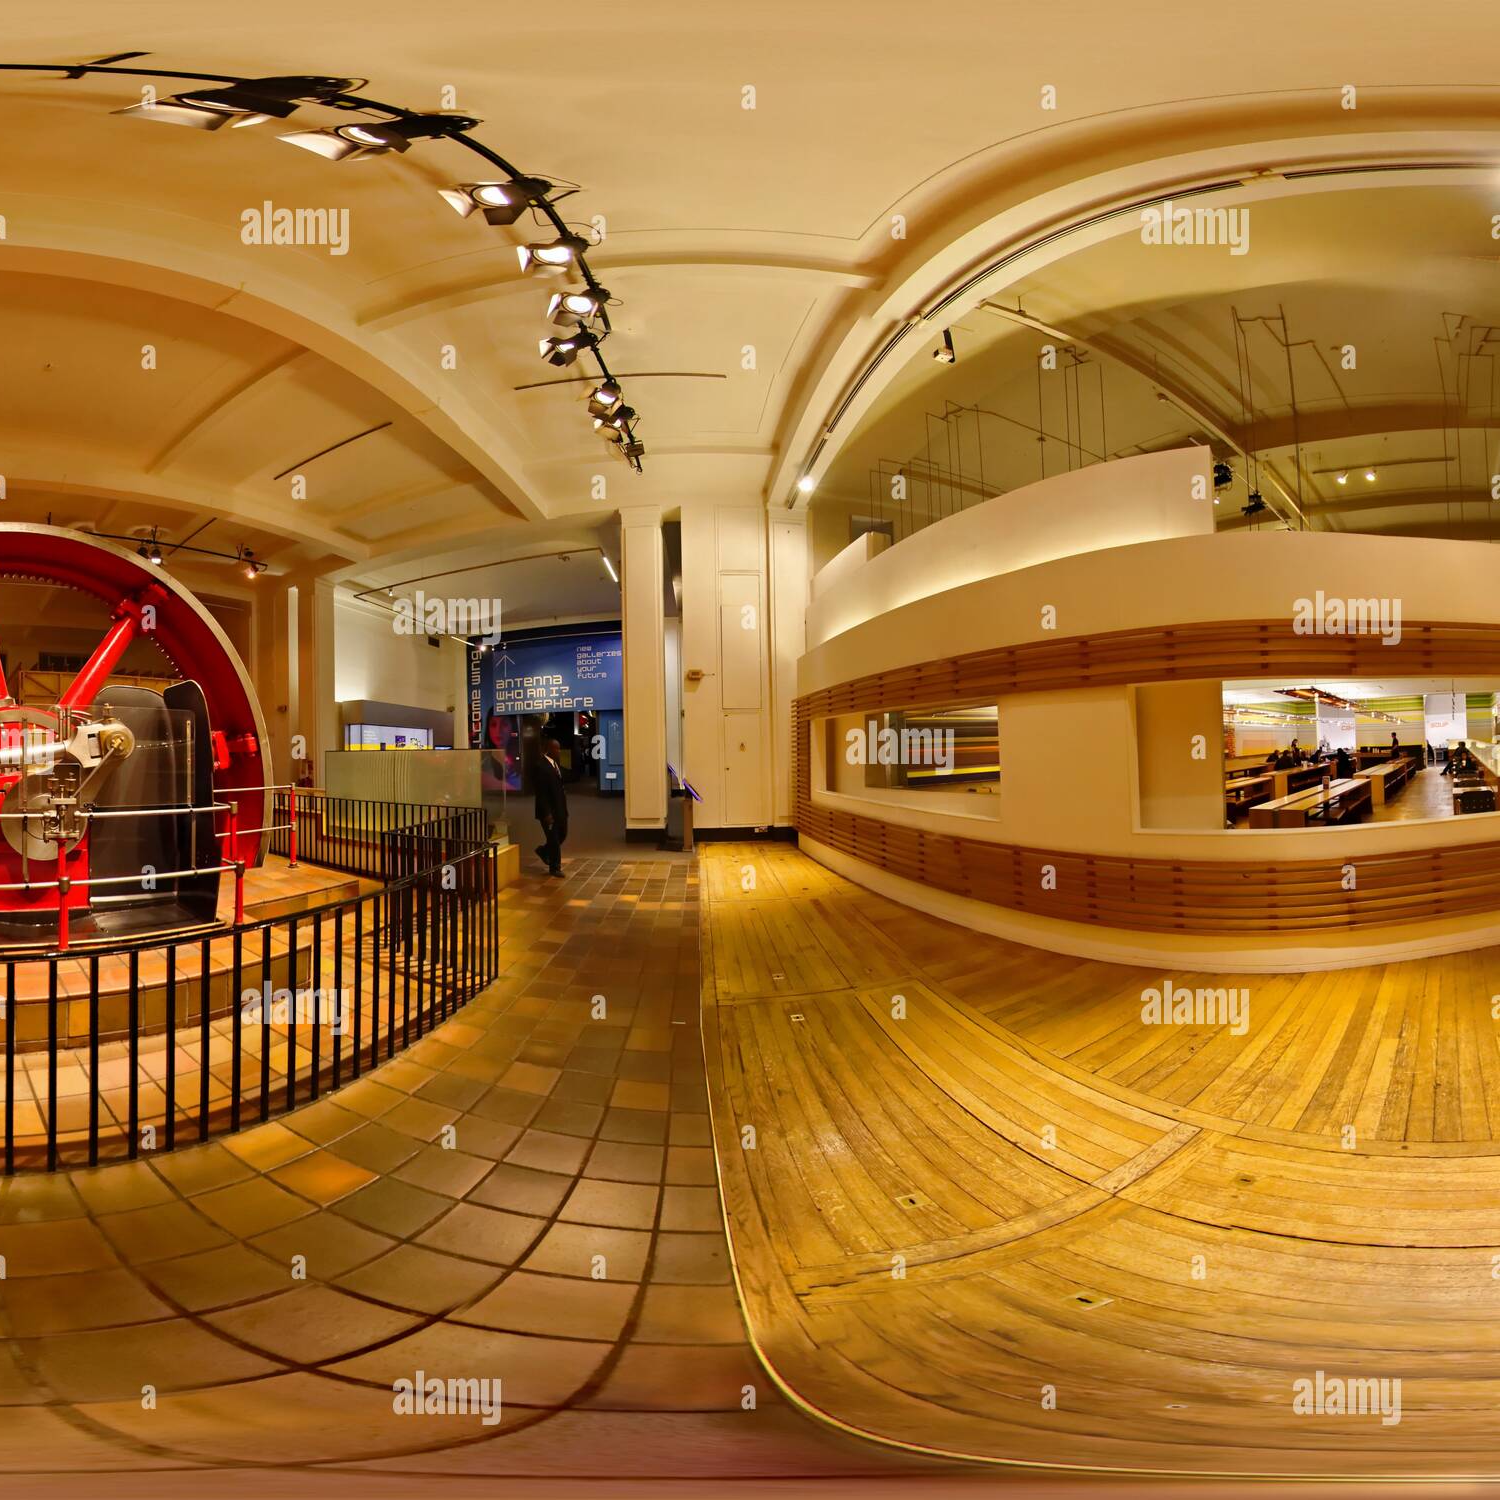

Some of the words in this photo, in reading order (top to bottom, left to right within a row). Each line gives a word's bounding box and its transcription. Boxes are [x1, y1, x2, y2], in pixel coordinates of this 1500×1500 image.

[576, 658, 602, 666] about
[496, 689, 524, 700] WHO
[527, 688, 546, 698] AM
[549, 686, 570, 697] I?
